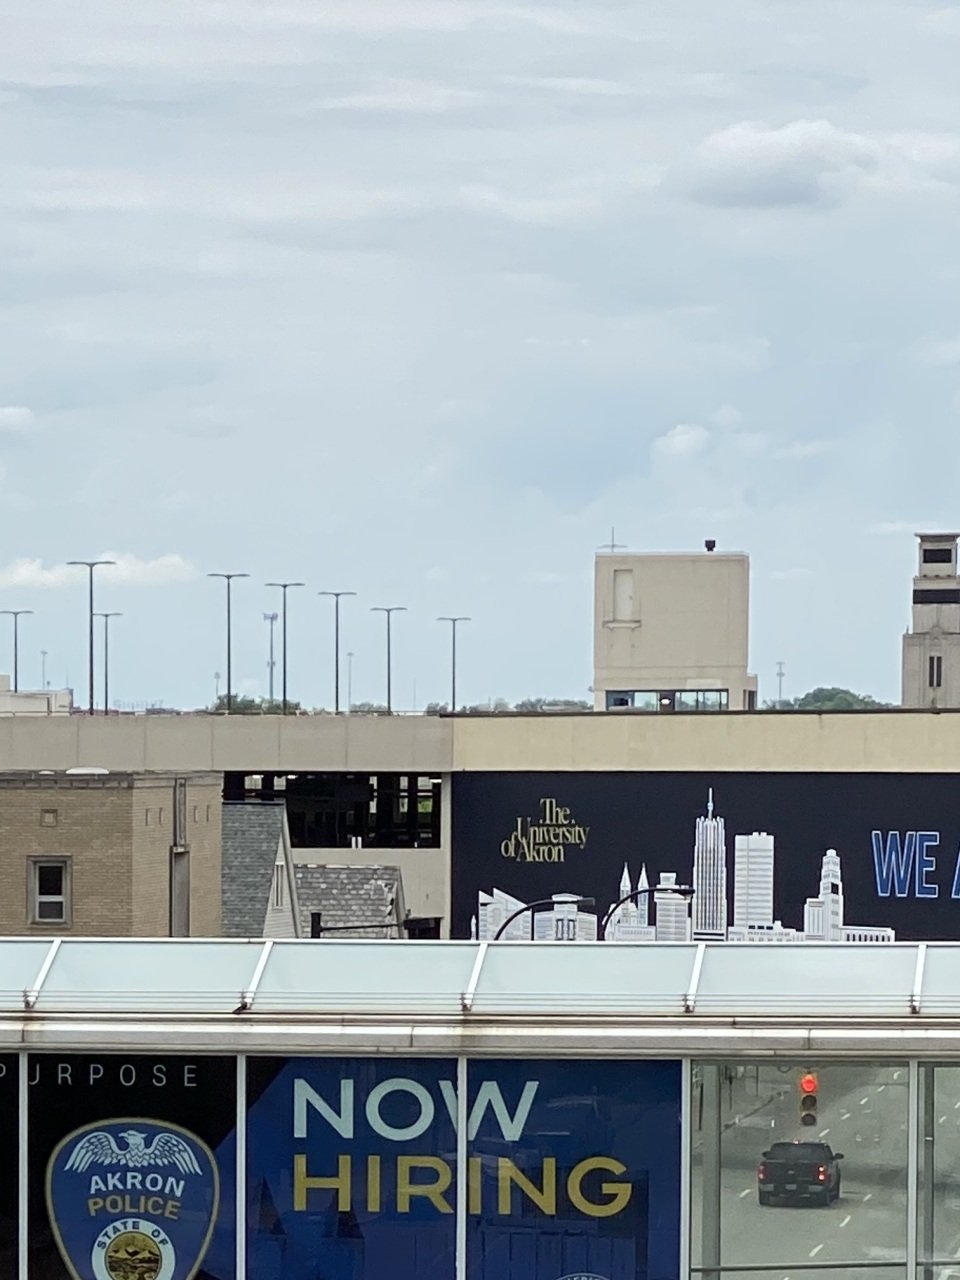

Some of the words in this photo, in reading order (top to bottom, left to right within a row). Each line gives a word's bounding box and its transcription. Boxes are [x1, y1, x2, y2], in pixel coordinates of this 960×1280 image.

[540, 798, 571, 824] The
[501, 831, 518, 857] of
[516, 836, 565, 862] Akron
[516, 817, 590, 849] University
[871, 830, 940, 898] WE
[293, 1078, 540, 1142] NOW
[90, 1171, 185, 1198] AKRON
[293, 1153, 633, 1218] HIRING
[87, 1194, 182, 1220] POLICE
[97, 1221, 140, 1250] STATE
[151, 1228, 169, 1247] OF
